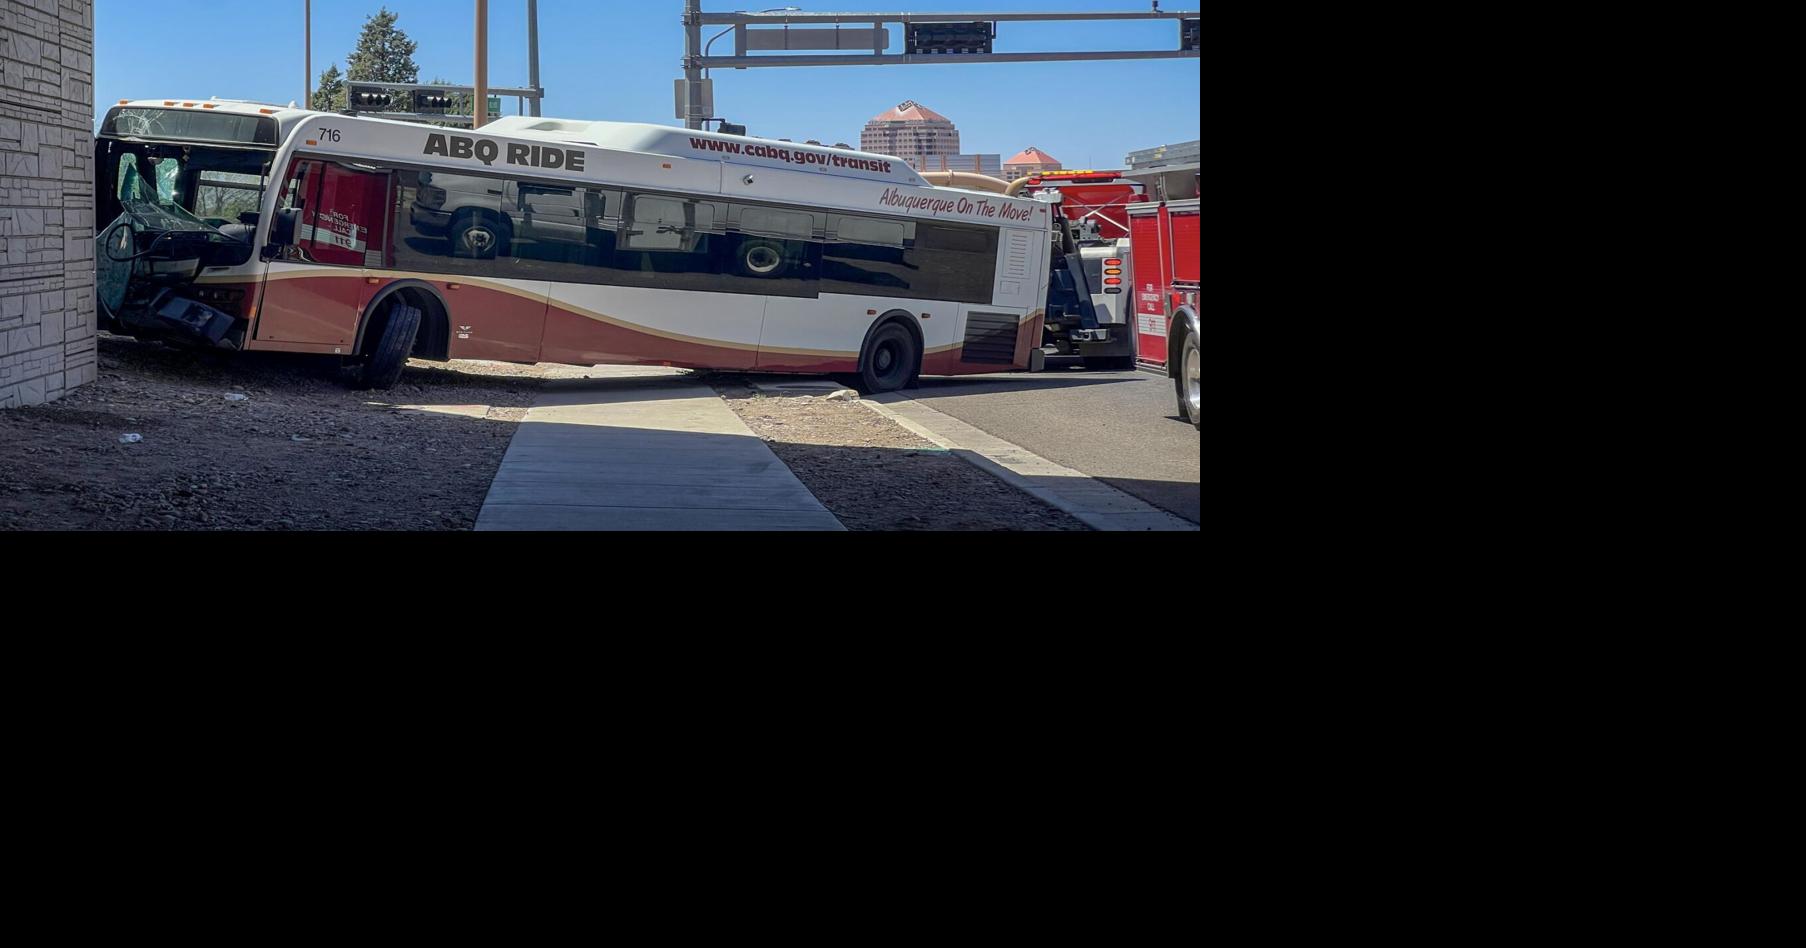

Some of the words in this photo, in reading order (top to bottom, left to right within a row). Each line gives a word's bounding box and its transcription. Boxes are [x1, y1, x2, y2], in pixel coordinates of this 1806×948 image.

[319, 127, 341, 142] 716
[423, 133, 499, 166] ABQ
[507, 142, 585, 172] RIDE
[689, 137, 891, 173] www.cabq.gov/transit
[879, 187, 954, 216] Albuquerque
[957, 197, 973, 213] On
[976, 200, 996, 217] The
[998, 202, 1034, 222] Move!
